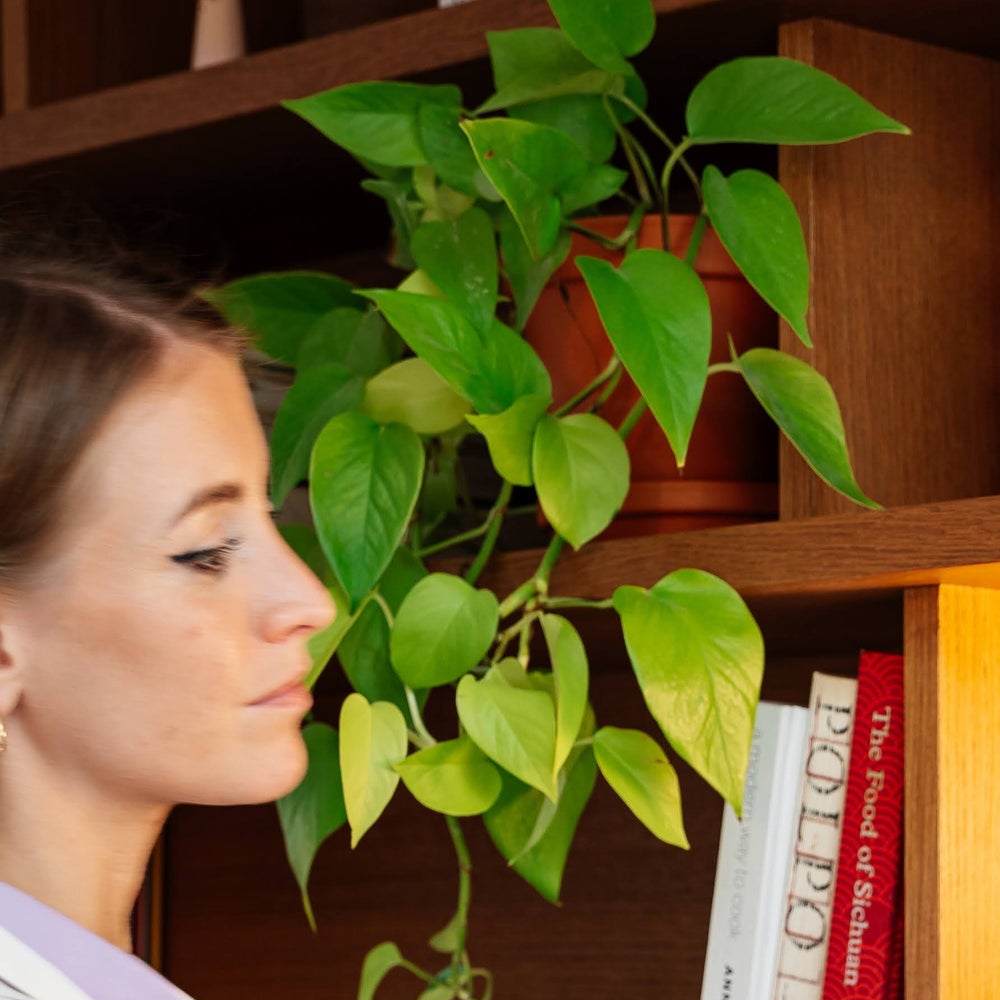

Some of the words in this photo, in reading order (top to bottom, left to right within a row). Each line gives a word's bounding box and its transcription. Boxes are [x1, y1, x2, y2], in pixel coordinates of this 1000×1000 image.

[868, 705, 892, 761] The
[784, 702, 851, 950] POLPO
[860, 768, 885, 839] Food
[857, 845, 875, 878] of
[843, 879, 873, 987] Sichuan
